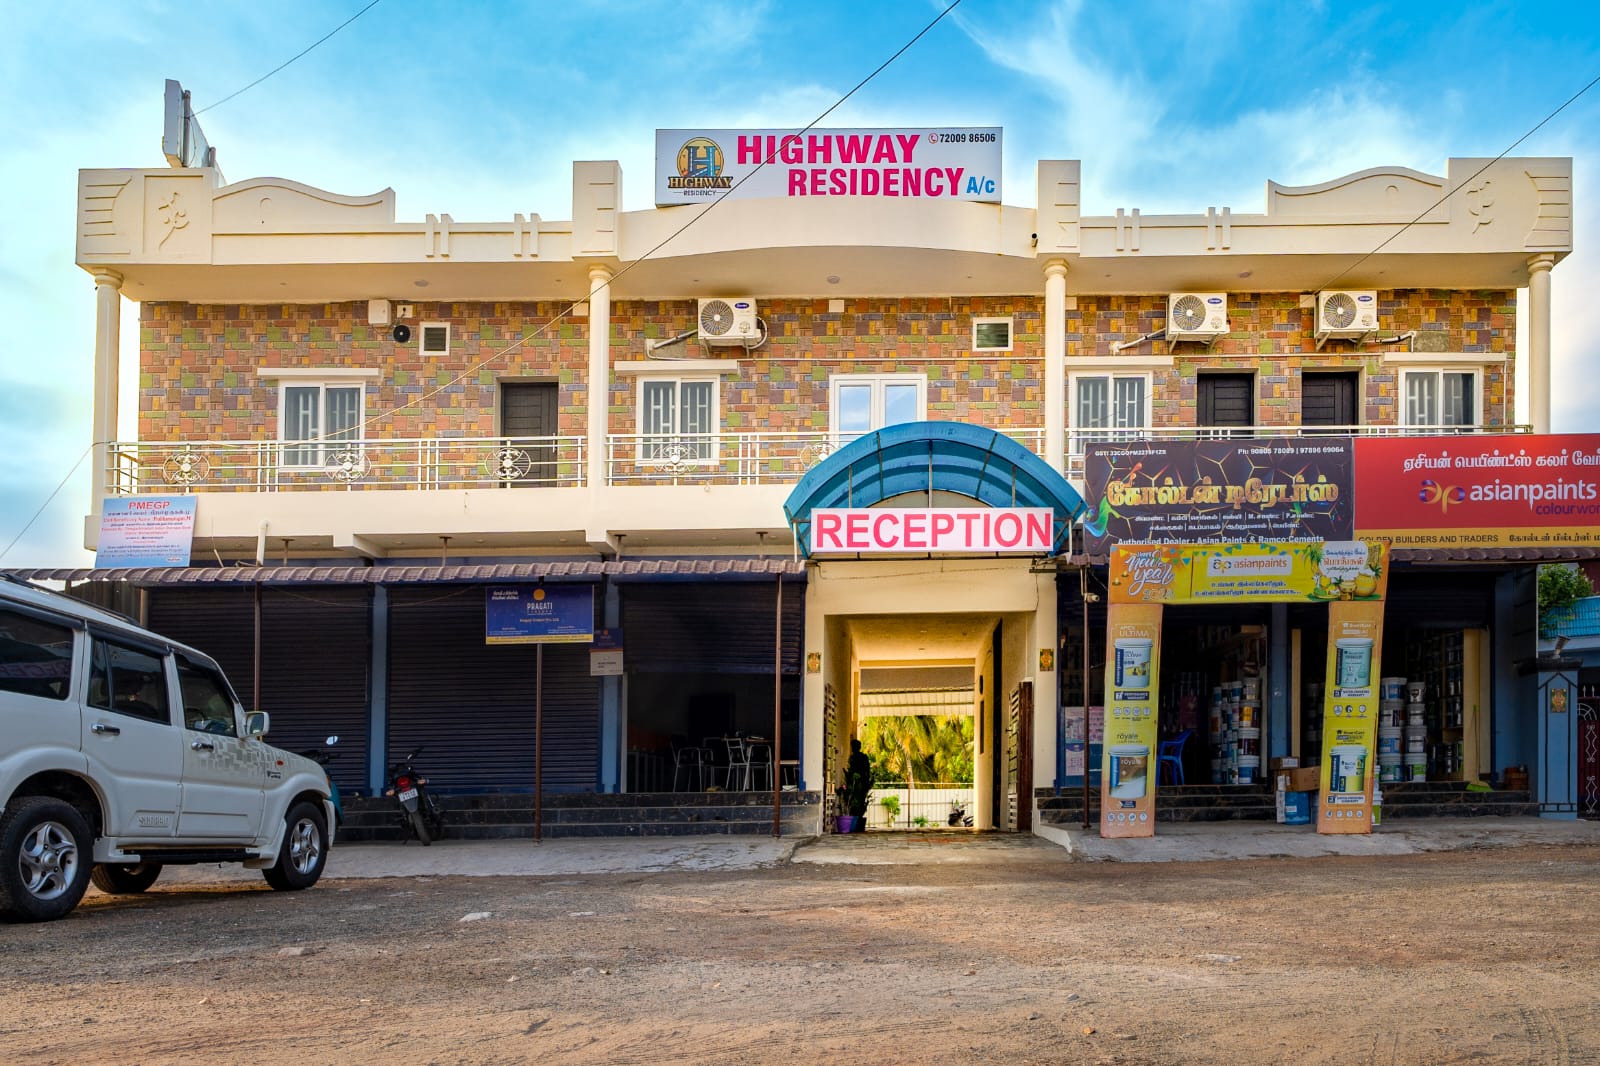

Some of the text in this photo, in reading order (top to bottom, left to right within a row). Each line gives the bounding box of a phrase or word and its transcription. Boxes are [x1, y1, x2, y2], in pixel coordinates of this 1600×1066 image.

[940, 133, 996, 143] 72009 86506
[737, 134, 920, 165] HIGHWAY
[668, 177, 732, 188] HIGHWAY
[788, 167, 996, 197] RESIDENCY A/c
[1403, 450, 1452, 473] ஏசியன்
[1455, 449, 1532, 468] பெயிண்ட்ஸ்
[1536, 448, 1569, 467] கலர்
[1107, 476, 1222, 507] கோல்டன்
[1469, 477, 1597, 512] asianpaints
[128, 501, 171, 510] PMEGP
[816, 512, 1051, 549] RECEPTION
[1118, 537, 1161, 545] Authorised
[1163, 537, 1190, 545] Dealer
[1222, 536, 1247, 544] Paints
[1258, 535, 1287, 543] Ramco
[1288, 535, 1325, 543] Cements
[1395, 535, 1437, 544] BUILDERS
[1439, 535, 1457, 543] AND
[1459, 534, 1498, 543] TRADERS
[1233, 558, 1288, 573] asianpaints
[526, 602, 553, 610] PRAGATI
